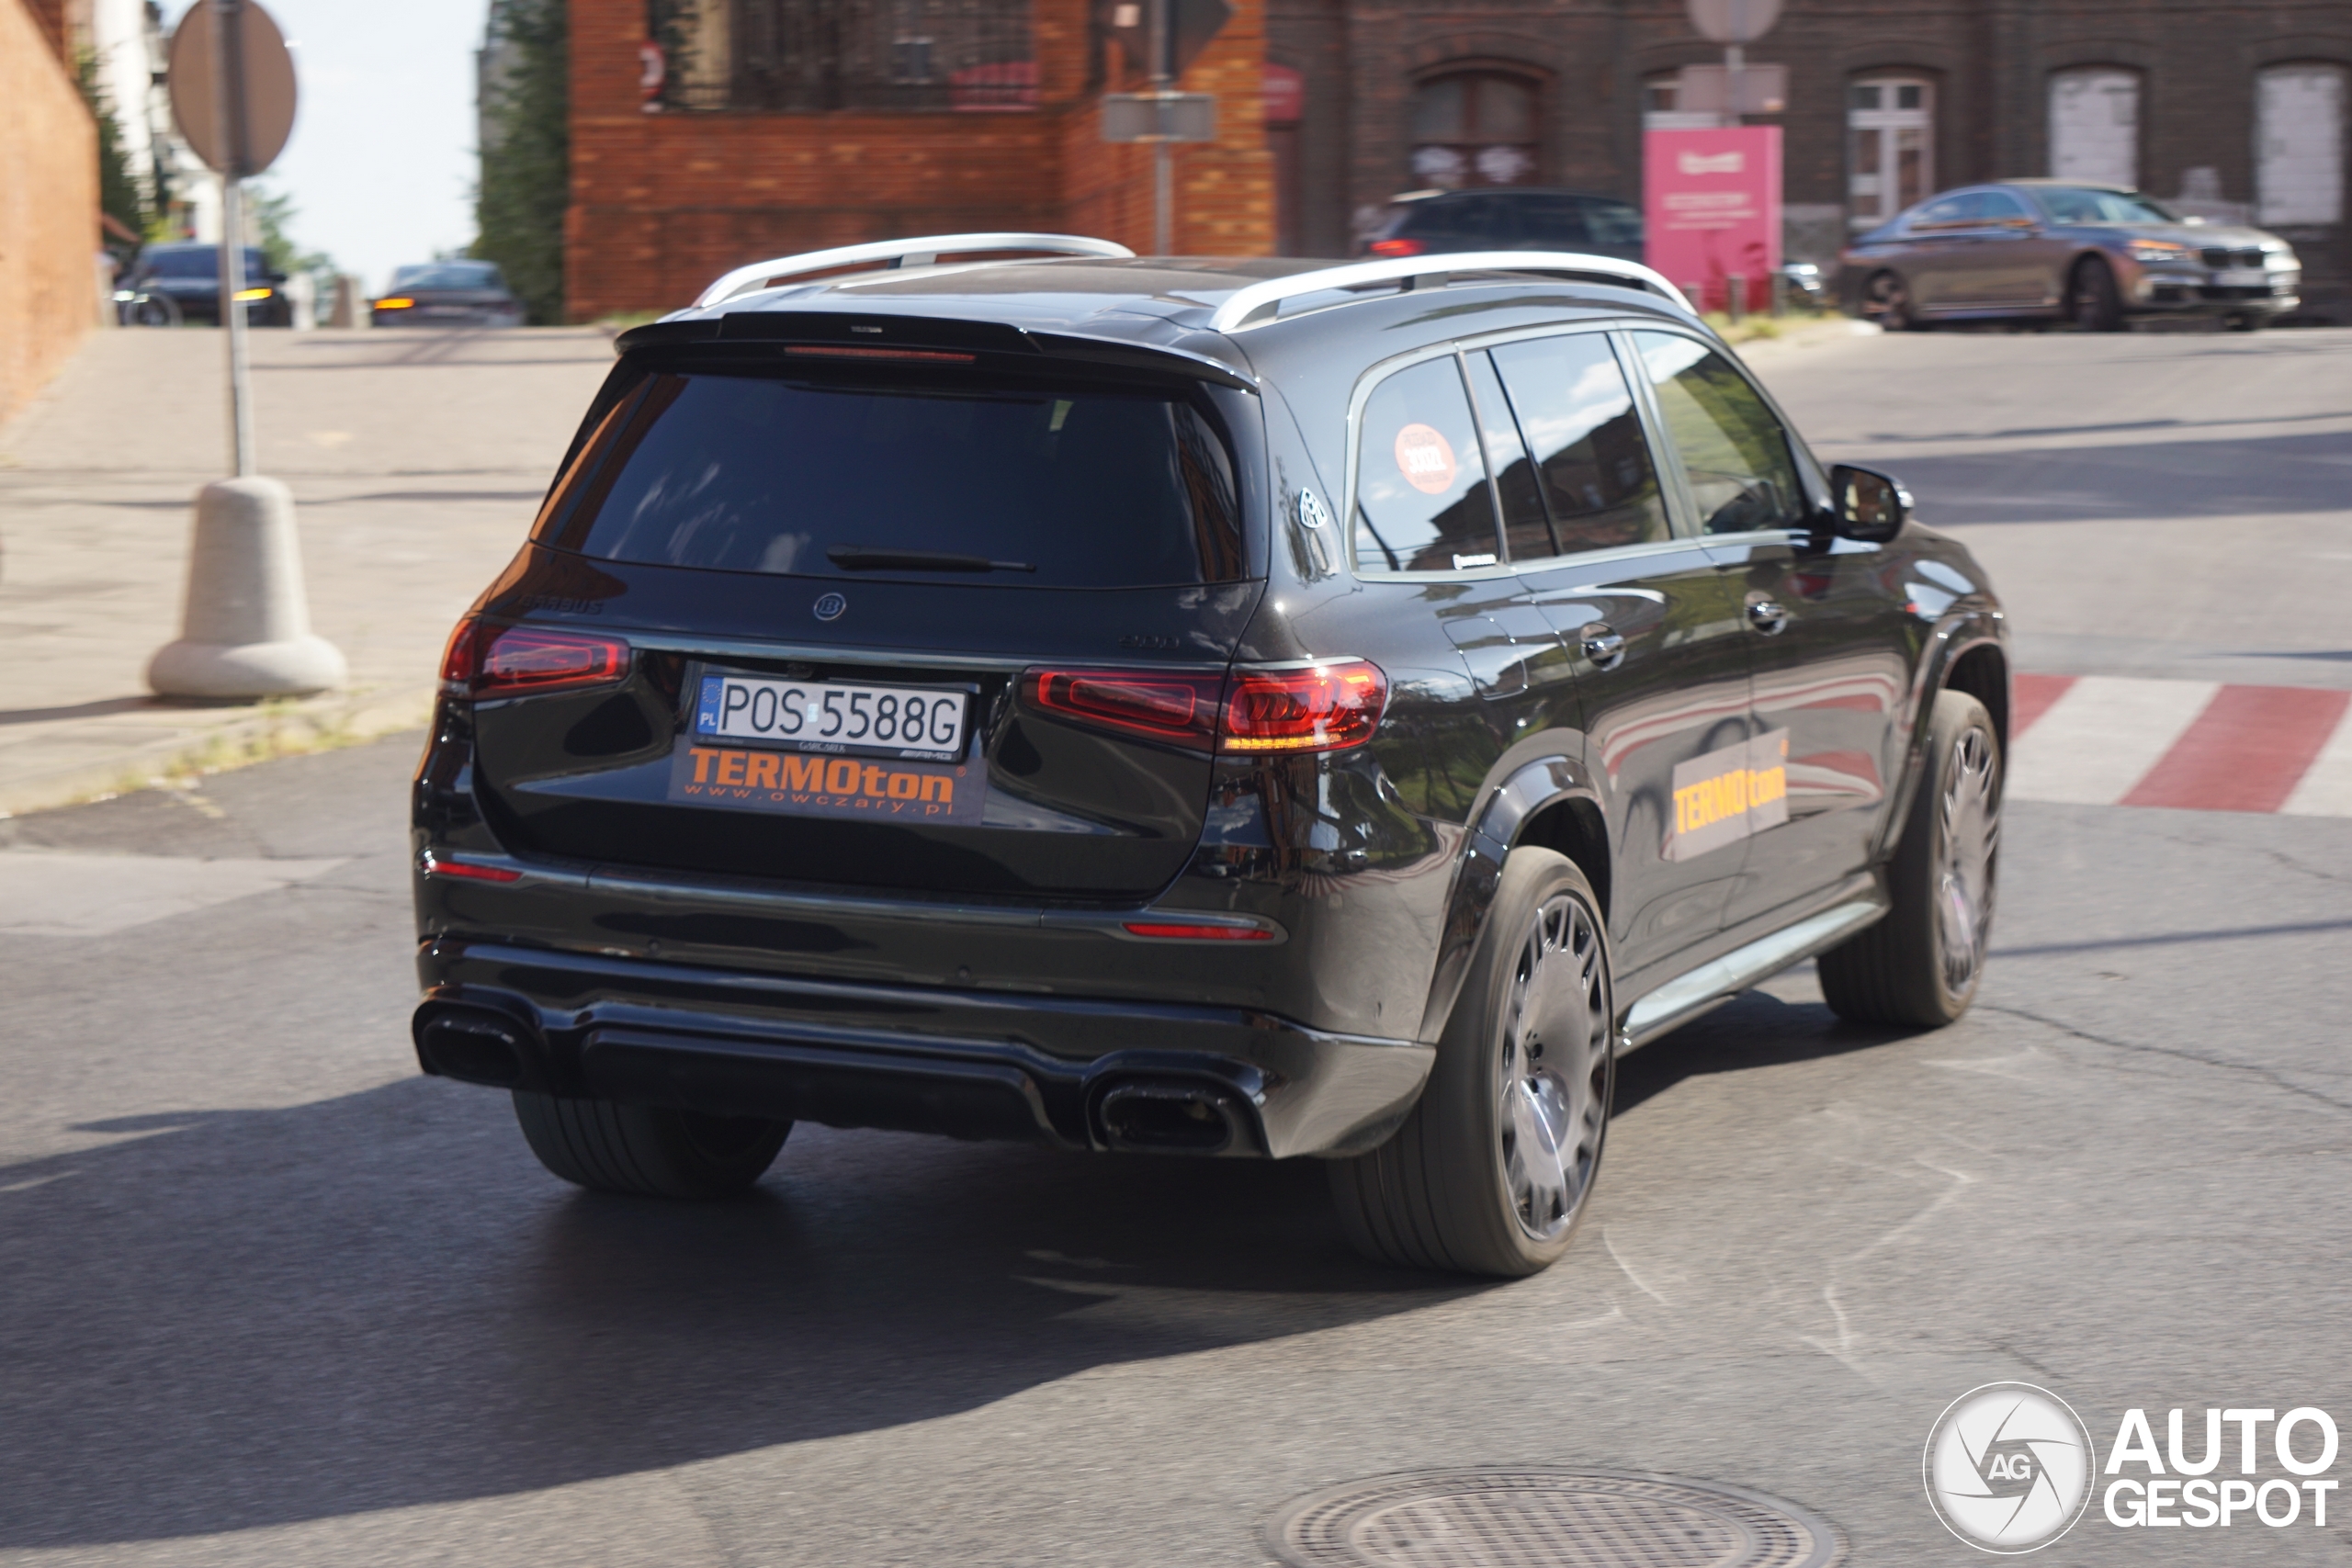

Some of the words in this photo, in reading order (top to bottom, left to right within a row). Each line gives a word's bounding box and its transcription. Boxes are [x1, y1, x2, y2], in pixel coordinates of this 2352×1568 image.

[699, 712, 718, 728] PL
[720, 683, 806, 734] POS
[819, 691, 957, 745] 5588G
[688, 747, 955, 804] TERMOton
[684, 784, 954, 816] www.owczary.pl
